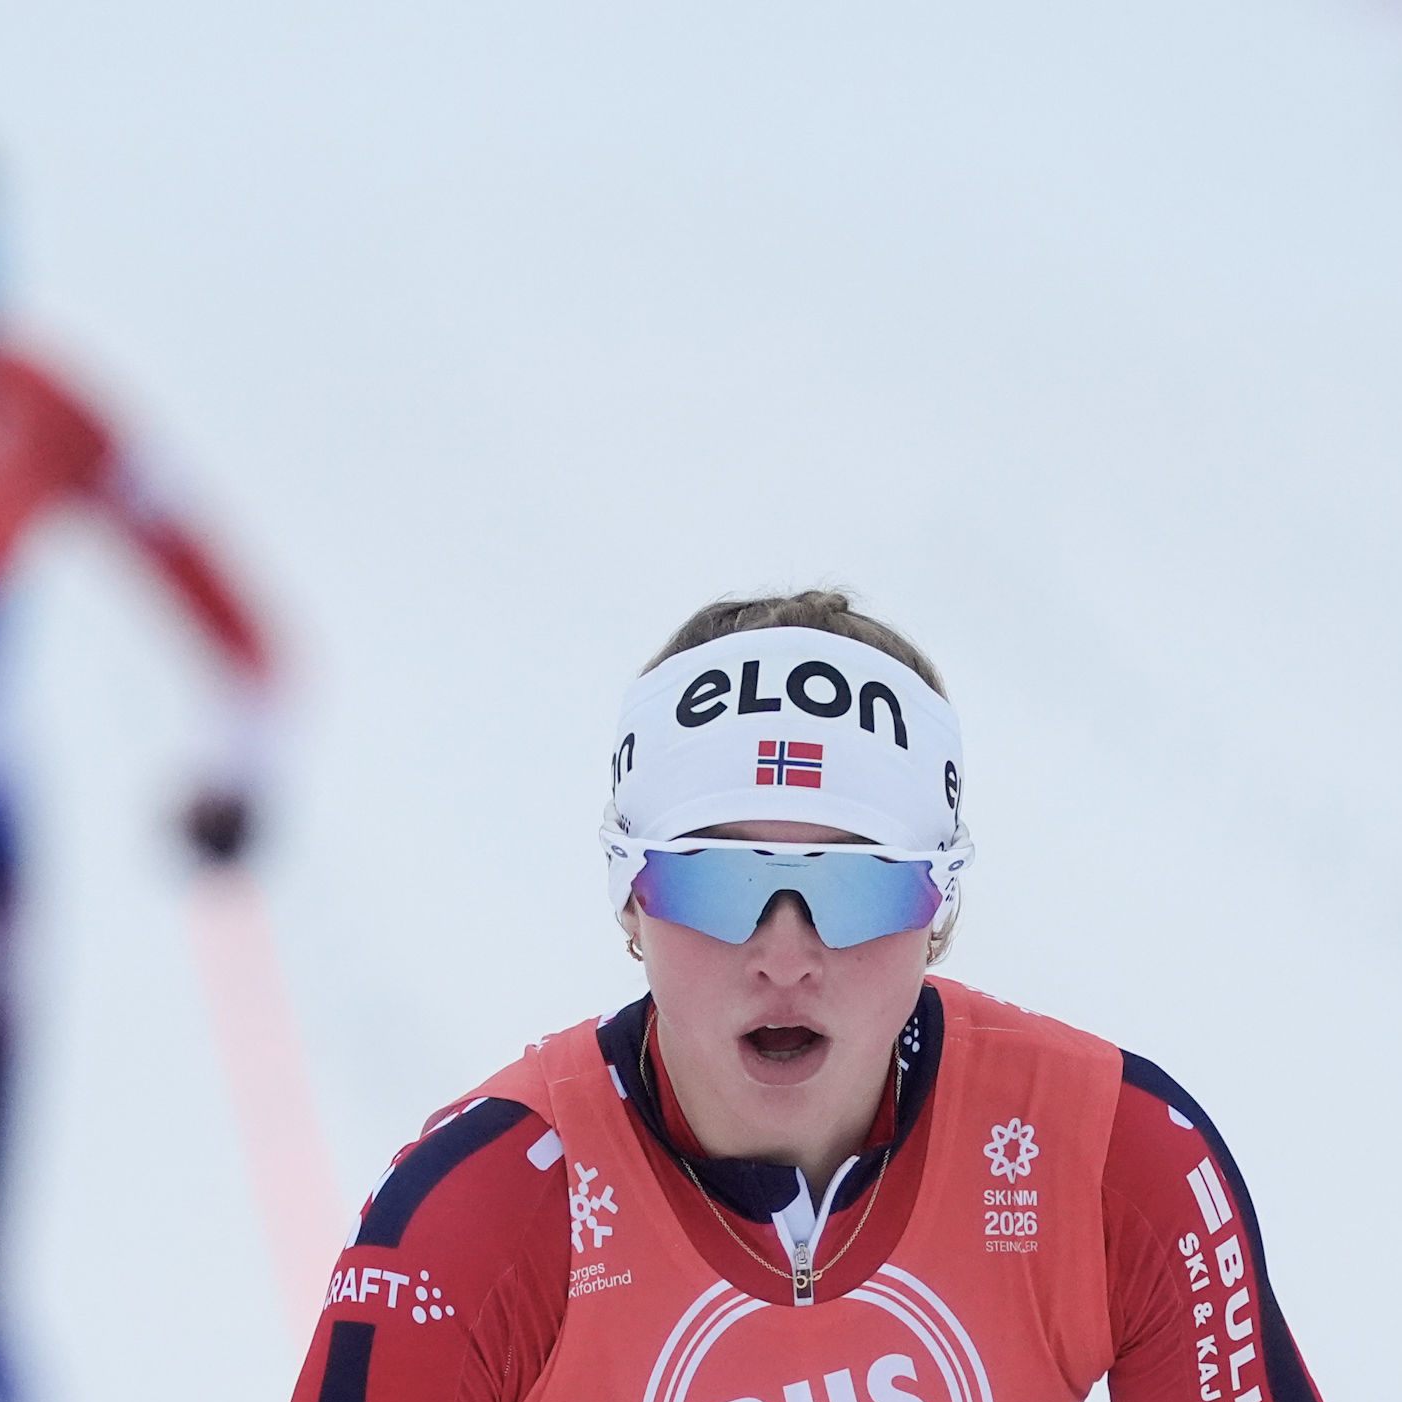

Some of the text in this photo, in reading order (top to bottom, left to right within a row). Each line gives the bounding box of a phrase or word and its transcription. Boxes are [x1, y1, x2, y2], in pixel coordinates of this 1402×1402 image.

[984, 1211, 1038, 1236] 2026
[569, 1262, 605, 1282] orges
[1178, 1231, 1211, 1291] SKI
[324, 1267, 410, 1310] RAFT
[568, 1269, 632, 1299] kiforbund
[1193, 1301, 1213, 1328] &
